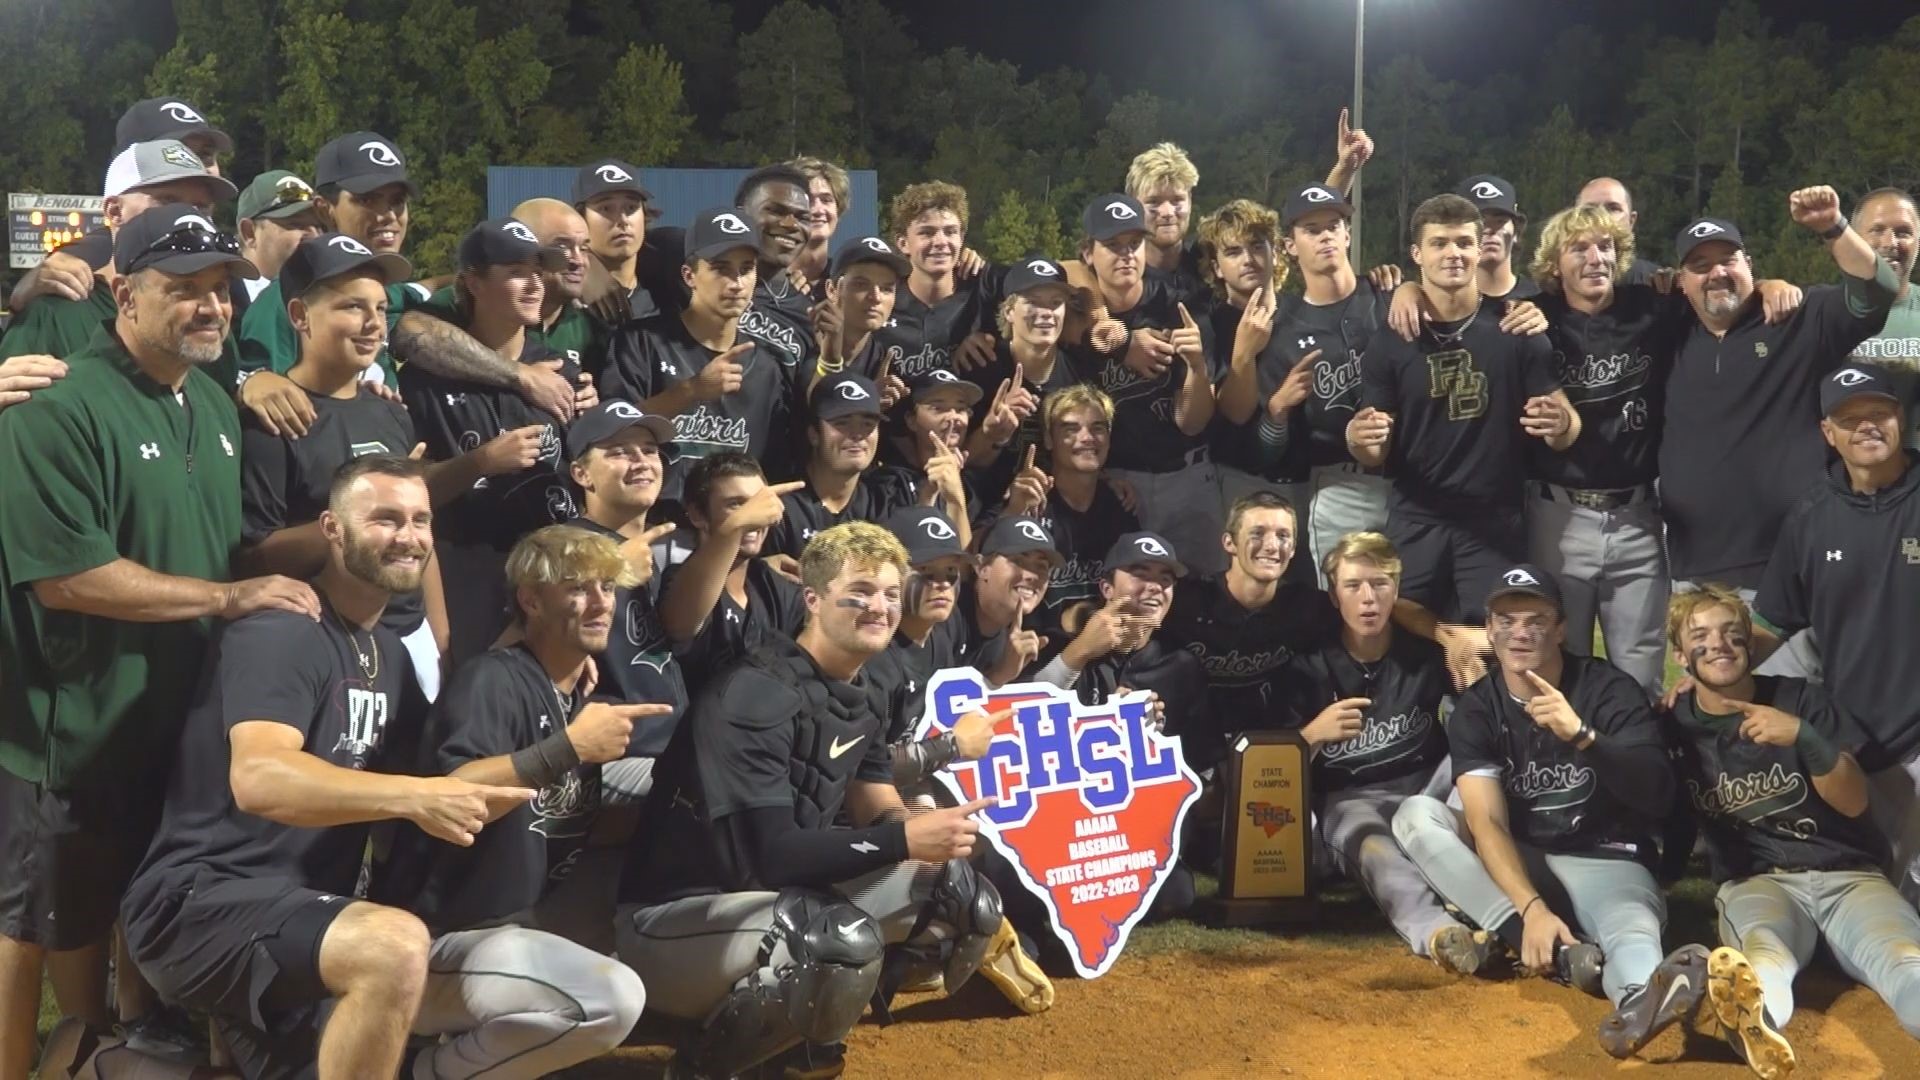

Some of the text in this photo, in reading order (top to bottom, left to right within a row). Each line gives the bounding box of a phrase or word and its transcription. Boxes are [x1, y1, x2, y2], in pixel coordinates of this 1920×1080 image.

[34, 196, 86, 209] BENGAL
[15, 232, 39, 240] GUEST
[1849, 338, 1920, 358] ATOR
[671, 406, 750, 450] ators
[934, 678, 1177, 824] SCHSL
[1261, 767, 1283, 777] STATE
[1253, 779, 1290, 789] CHAMPION
[1075, 814, 1117, 837] AAAAA
[1068, 834, 1129, 860] BASEBALL
[1045, 850, 1157, 887] STATE CHAMPIONS
[1070, 875, 1140, 904] 2022-2023
